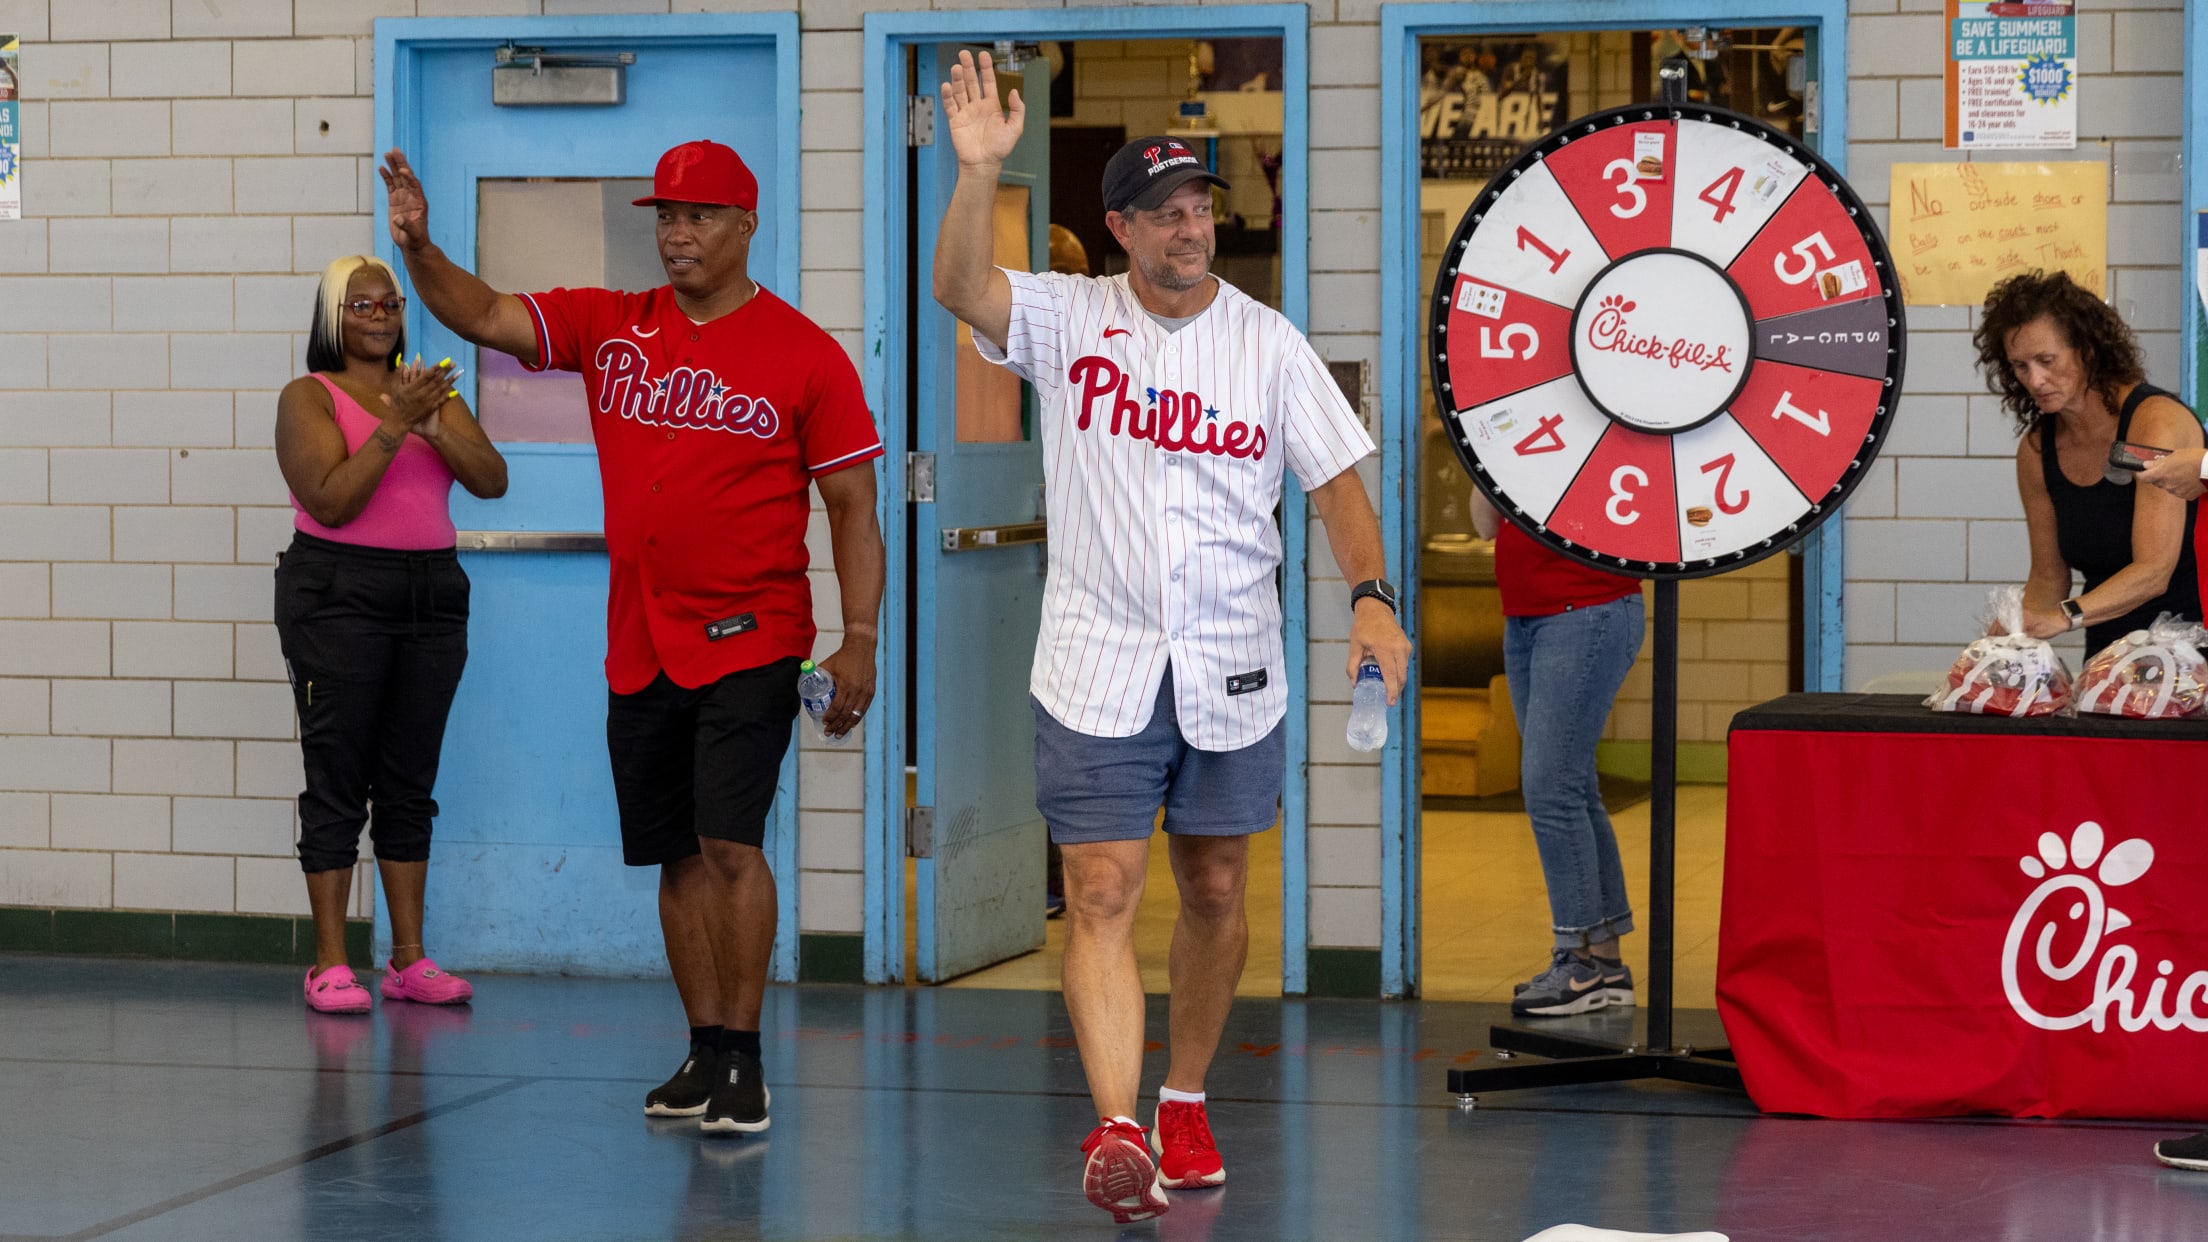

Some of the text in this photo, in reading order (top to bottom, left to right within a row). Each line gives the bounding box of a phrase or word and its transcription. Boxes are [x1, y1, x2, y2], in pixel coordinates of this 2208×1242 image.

[1961, 20, 2062, 37] SAVE SUMMER!
[2027, 5, 2065, 15] LIFEGUARD
[1956, 38, 2068, 55] BE A LIFEGUARD!
[1967, 87, 1983, 96] FREE
[2029, 67, 2063, 84] $1000
[1468, 92, 1559, 139] ARE
[1967, 98, 1983, 107] FREE
[1144, 145, 1161, 166] P
[1602, 158, 1648, 219] 3
[1698, 166, 1745, 223] 4
[1910, 178, 1945, 217] No
[1969, 191, 2018, 212] outside
[2033, 193, 2063, 206] shoes
[1516, 225, 1571, 274] 1
[1773, 230, 1836, 285] 5
[1957, 235, 1972, 245] on
[1977, 229, 1994, 240] the
[1970, 256, 1986, 266] the
[1480, 321, 1540, 361] 5
[1588, 295, 1733, 374] Chick-fil-A
[1770, 331, 1880, 344] SPECIAL
[596, 338, 779, 439] Phillies
[1069, 355, 1267, 461] Phillies
[1771, 390, 1831, 437] 1
[1513, 413, 1567, 457] 4
[1605, 465, 1649, 526] 3
[1700, 453, 1750, 515] 2
